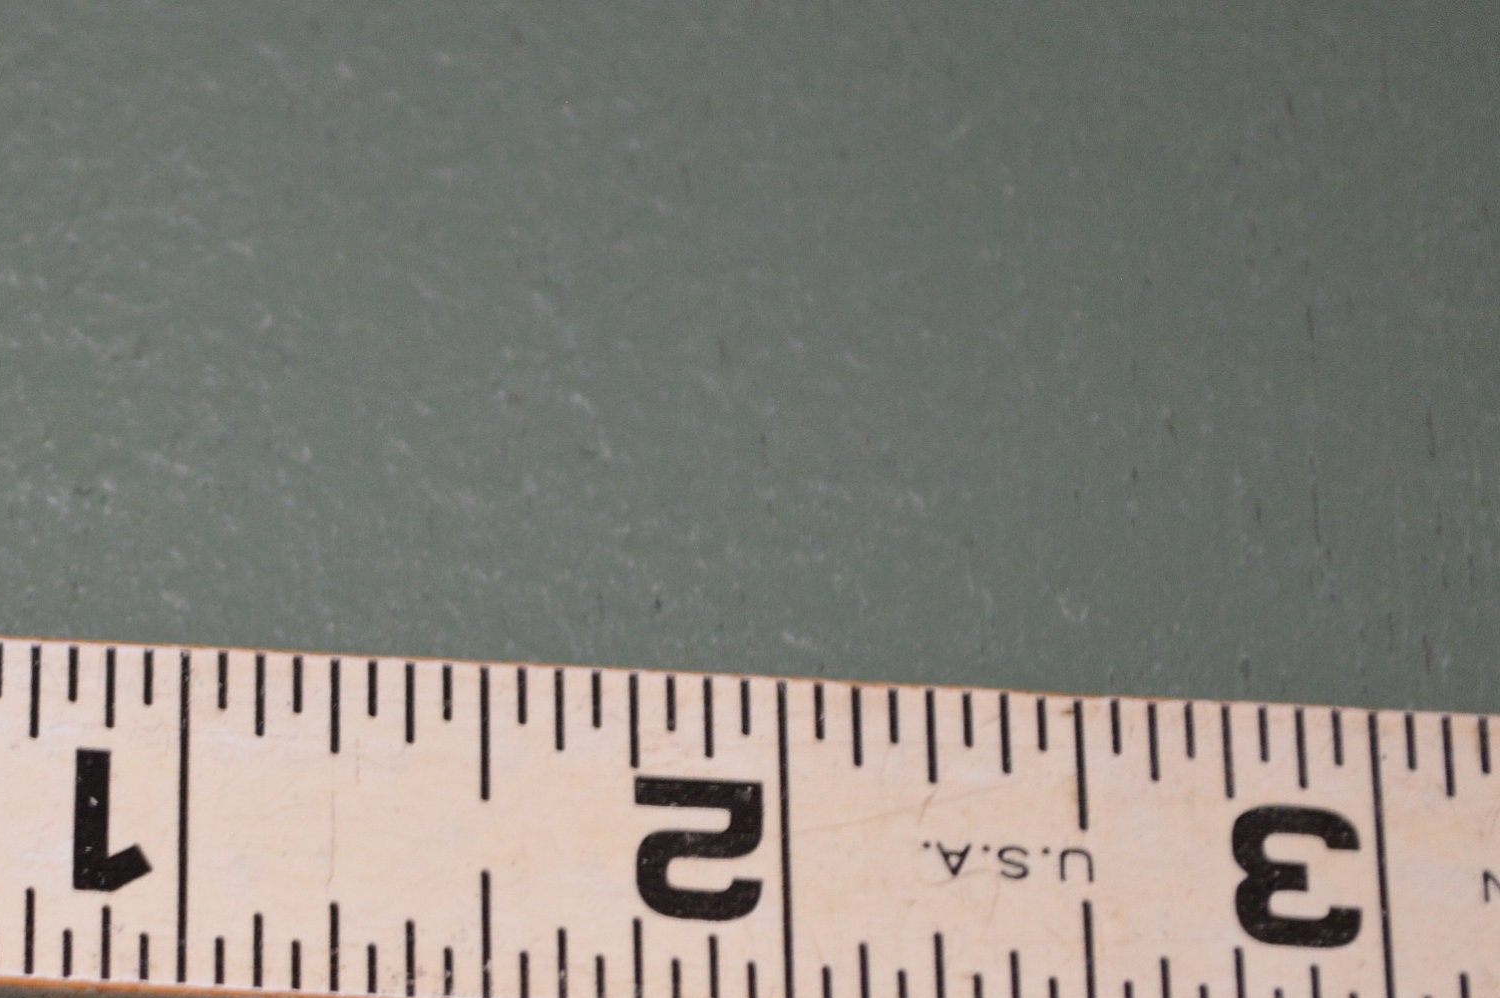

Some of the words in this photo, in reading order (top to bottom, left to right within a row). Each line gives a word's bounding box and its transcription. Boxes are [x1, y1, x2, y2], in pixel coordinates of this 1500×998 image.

[73, 748, 152, 893] 1
[634, 775, 764, 922] 2
[922, 841, 1095, 883] U.S.A.
[1231, 805, 1362, 949] 3
